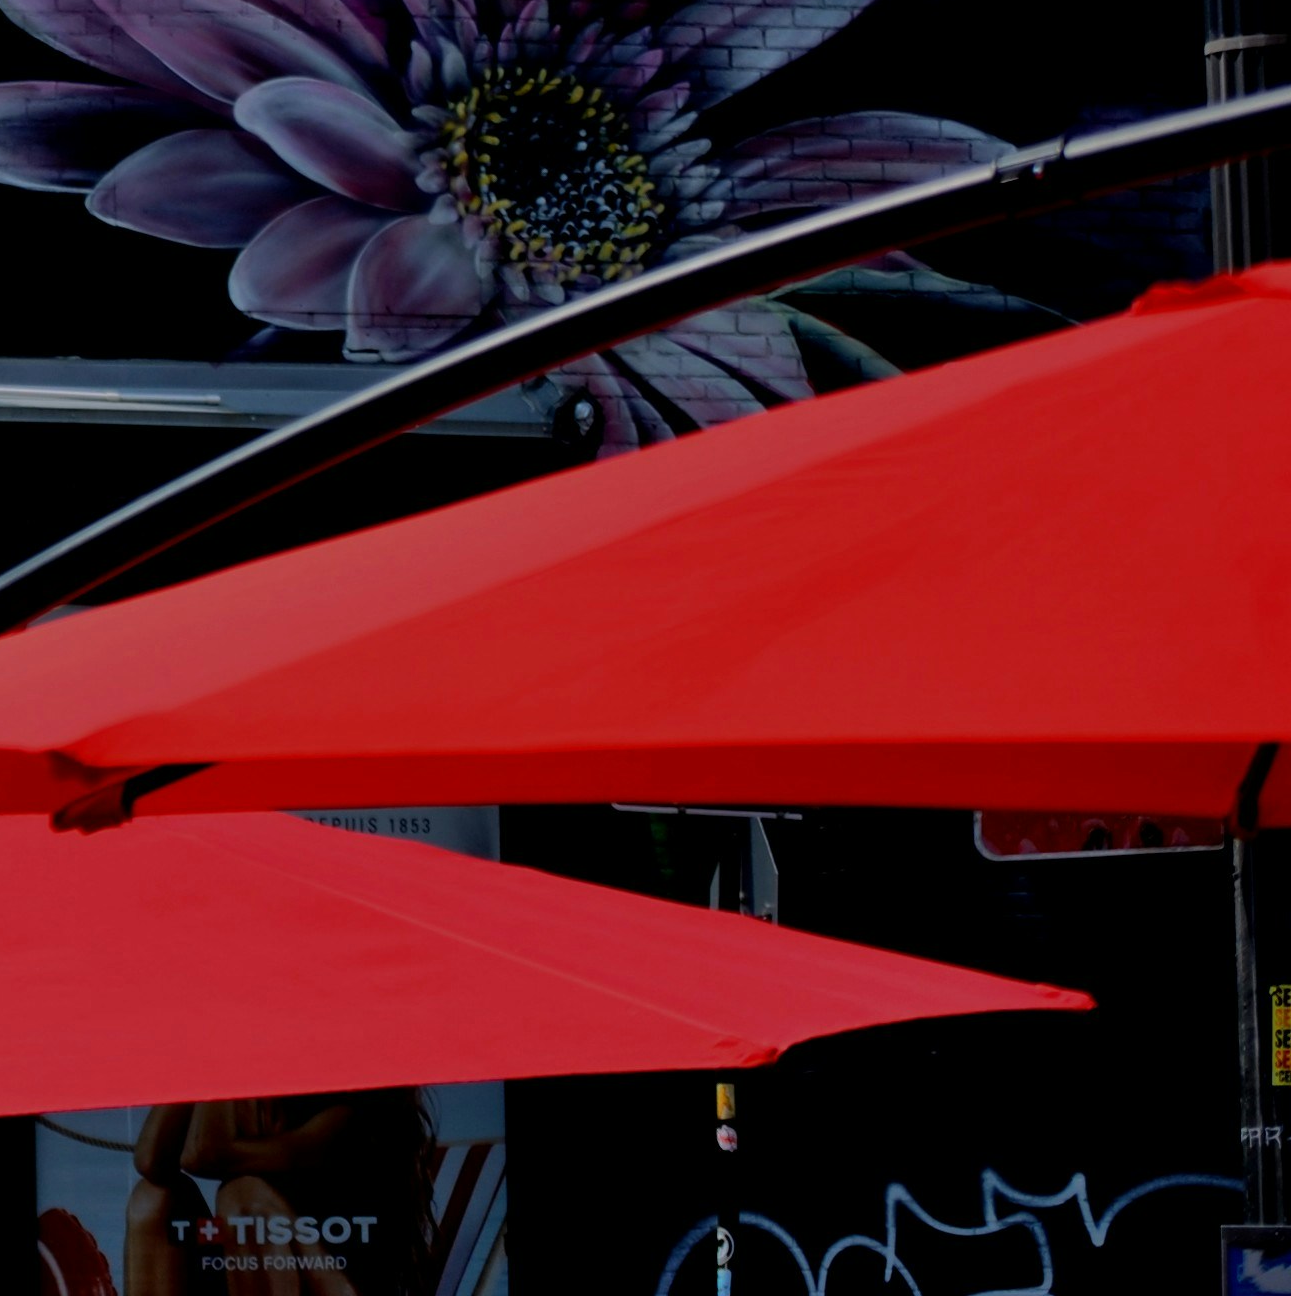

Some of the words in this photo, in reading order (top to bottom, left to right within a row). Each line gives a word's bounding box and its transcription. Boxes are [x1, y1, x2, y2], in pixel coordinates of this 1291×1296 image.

[389, 817, 431, 834] 1853
[227, 1215, 378, 1246] TISSOT
[201, 1256, 259, 1271] FOCUS
[263, 1255, 347, 1271] FORWARD
